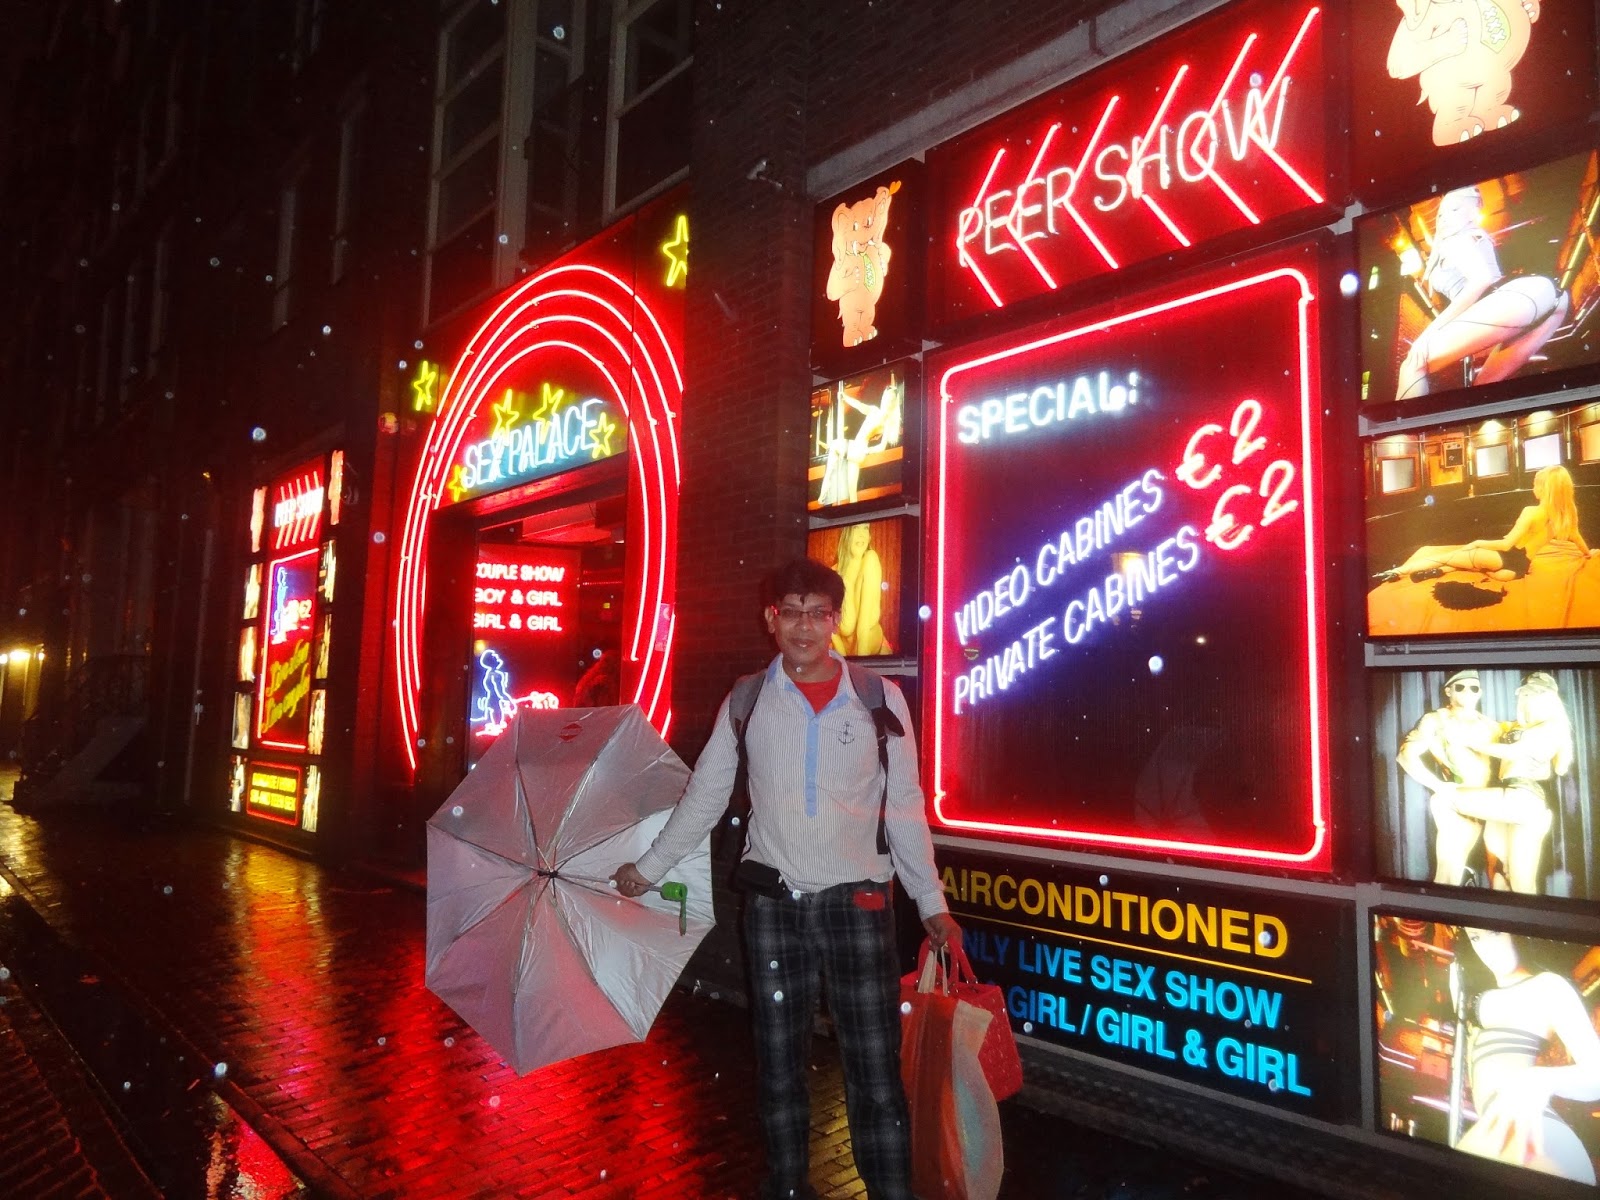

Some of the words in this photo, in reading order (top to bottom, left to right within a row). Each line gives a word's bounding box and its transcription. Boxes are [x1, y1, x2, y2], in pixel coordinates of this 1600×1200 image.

[1094, 75, 1291, 212] SHOW
[463, 437, 507, 489] SEX
[508, 398, 603, 476] PALACE
[510, 589, 524, 605] &
[526, 590, 563, 606] GIRL
[520, 564, 565, 582] SHOW
[955, 565, 1029, 645] VIDEO
[1037, 469, 1165, 586] CABINES
[509, 613, 522, 629] &
[527, 615, 563, 631] GIRL
[954, 617, 1058, 714] PRIVATE
[1064, 525, 1199, 643] CABINES
[943, 866, 1289, 958] AIRCONDITIONED
[962, 928, 1010, 966] NLY
[1018, 938, 1083, 984] LIVE
[1090, 955, 1156, 1001] SEX
[1165, 971, 1282, 1030] SHOW
[1007, 987, 1076, 1033] GIRL
[1096, 1007, 1175, 1060] GIRL
[1183, 1029, 1208, 1069] &
[1215, 1037, 1312, 1097] GIRL
